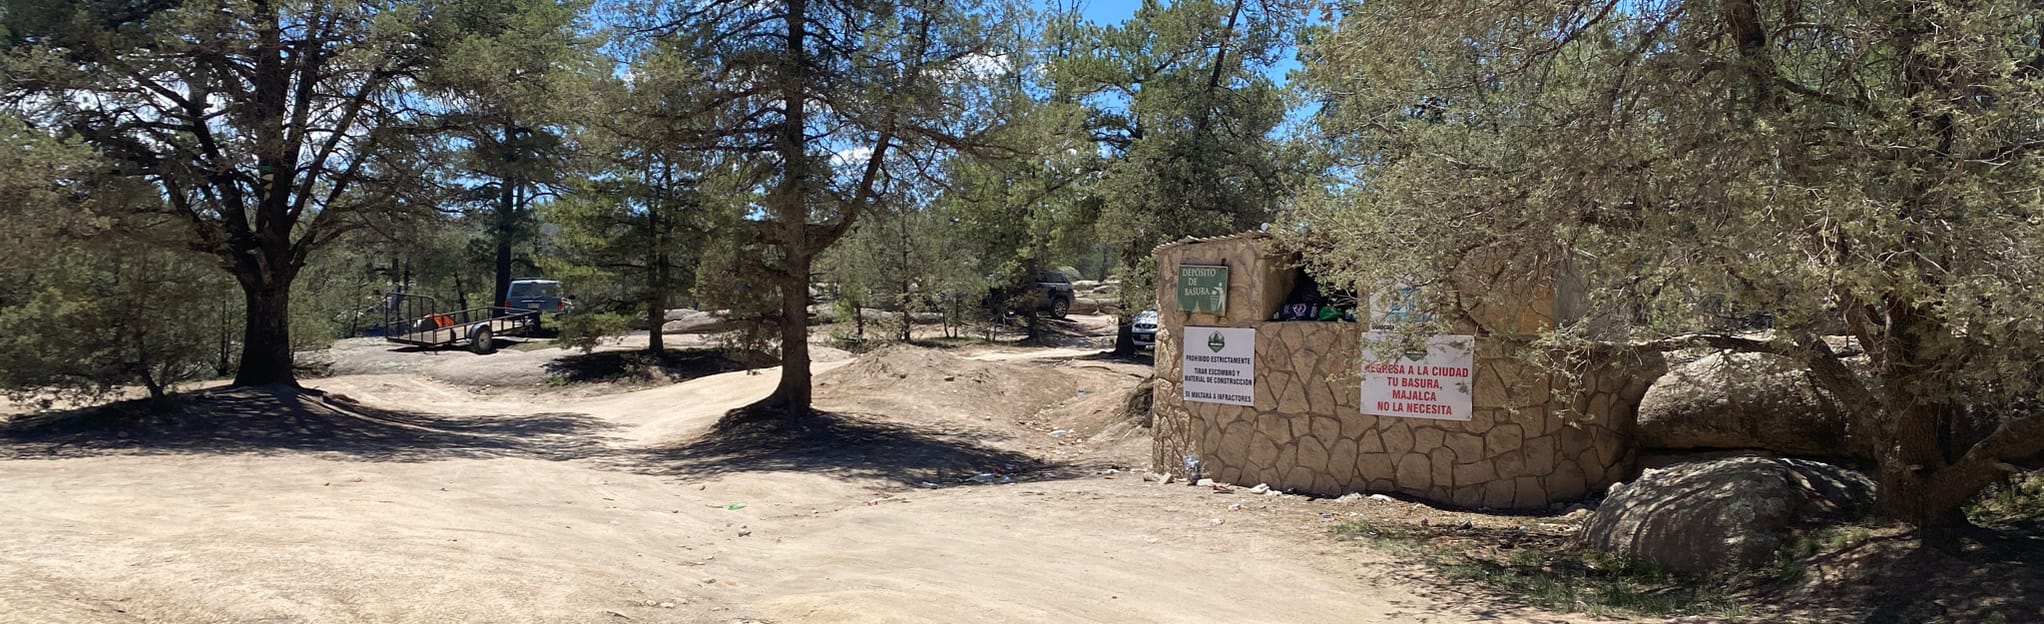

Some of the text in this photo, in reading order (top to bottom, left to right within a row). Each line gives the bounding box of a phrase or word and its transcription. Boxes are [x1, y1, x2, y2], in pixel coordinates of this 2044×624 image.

[1188, 277, 1198, 286] DE
[1184, 287, 1210, 296] BASURA
[1186, 355, 1250, 365] PROHIBIDO ESTRICTAMENTE
[1194, 367, 1208, 375] TIRAR
[1208, 368, 1236, 376] ESCOMBRO
[1407, 365, 1415, 375] A
[1417, 365, 1429, 376] LA
[1431, 366, 1469, 378] CIUDAD
[1184, 375, 1206, 383] MATERIAL
[1206, 376, 1213, 384] DE
[1387, 376, 1399, 387] TU
[1185, 390, 1191, 398] SE
[1217, 393, 1252, 403] INFRACTORES
[1392, 390, 1437, 401] MAJALCA
[1377, 401, 1452, 416] NO LA NECESITA
